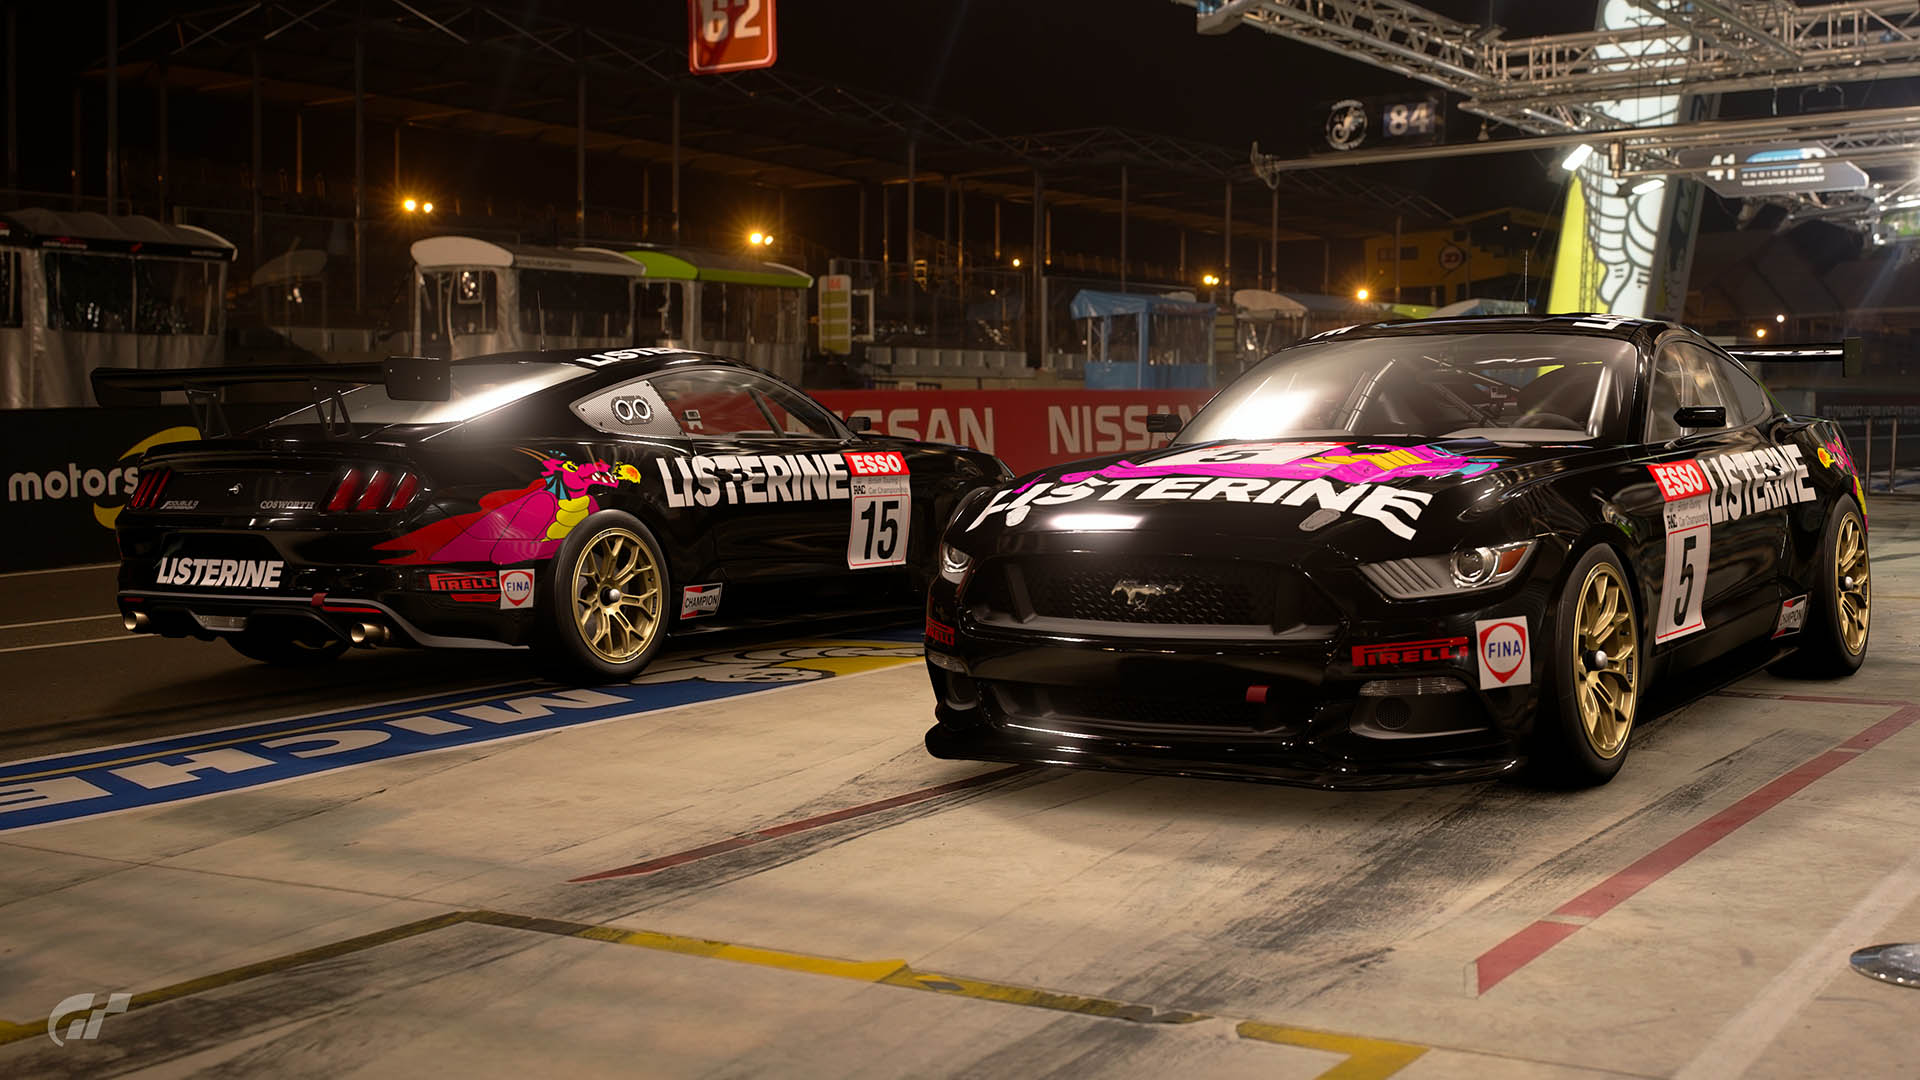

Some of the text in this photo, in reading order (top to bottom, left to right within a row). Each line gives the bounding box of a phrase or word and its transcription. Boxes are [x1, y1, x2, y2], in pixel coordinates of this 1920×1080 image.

[703, 0, 761, 43] 62
[1388, 103, 1430, 136] 84
[851, 454, 902, 474] ESSO
[1655, 463, 1704, 497] ESSO
[656, 453, 850, 508] LISTERINE
[1698, 443, 1817, 525] LISTERINE
[260, 500, 314, 510] COSWORTH
[966, 475, 1433, 540] LISTERINE
[861, 500, 899, 560] 15
[156, 557, 285, 588] LISTERINE
[428, 571, 498, 591] PIRELLI
[506, 581, 530, 592] FINA
[1673, 535, 1697, 626] 5
[685, 593, 718, 608] CHAMPION
[1351, 636, 1470, 667] PIRELLI
[1488, 640, 1522, 658] FINA
